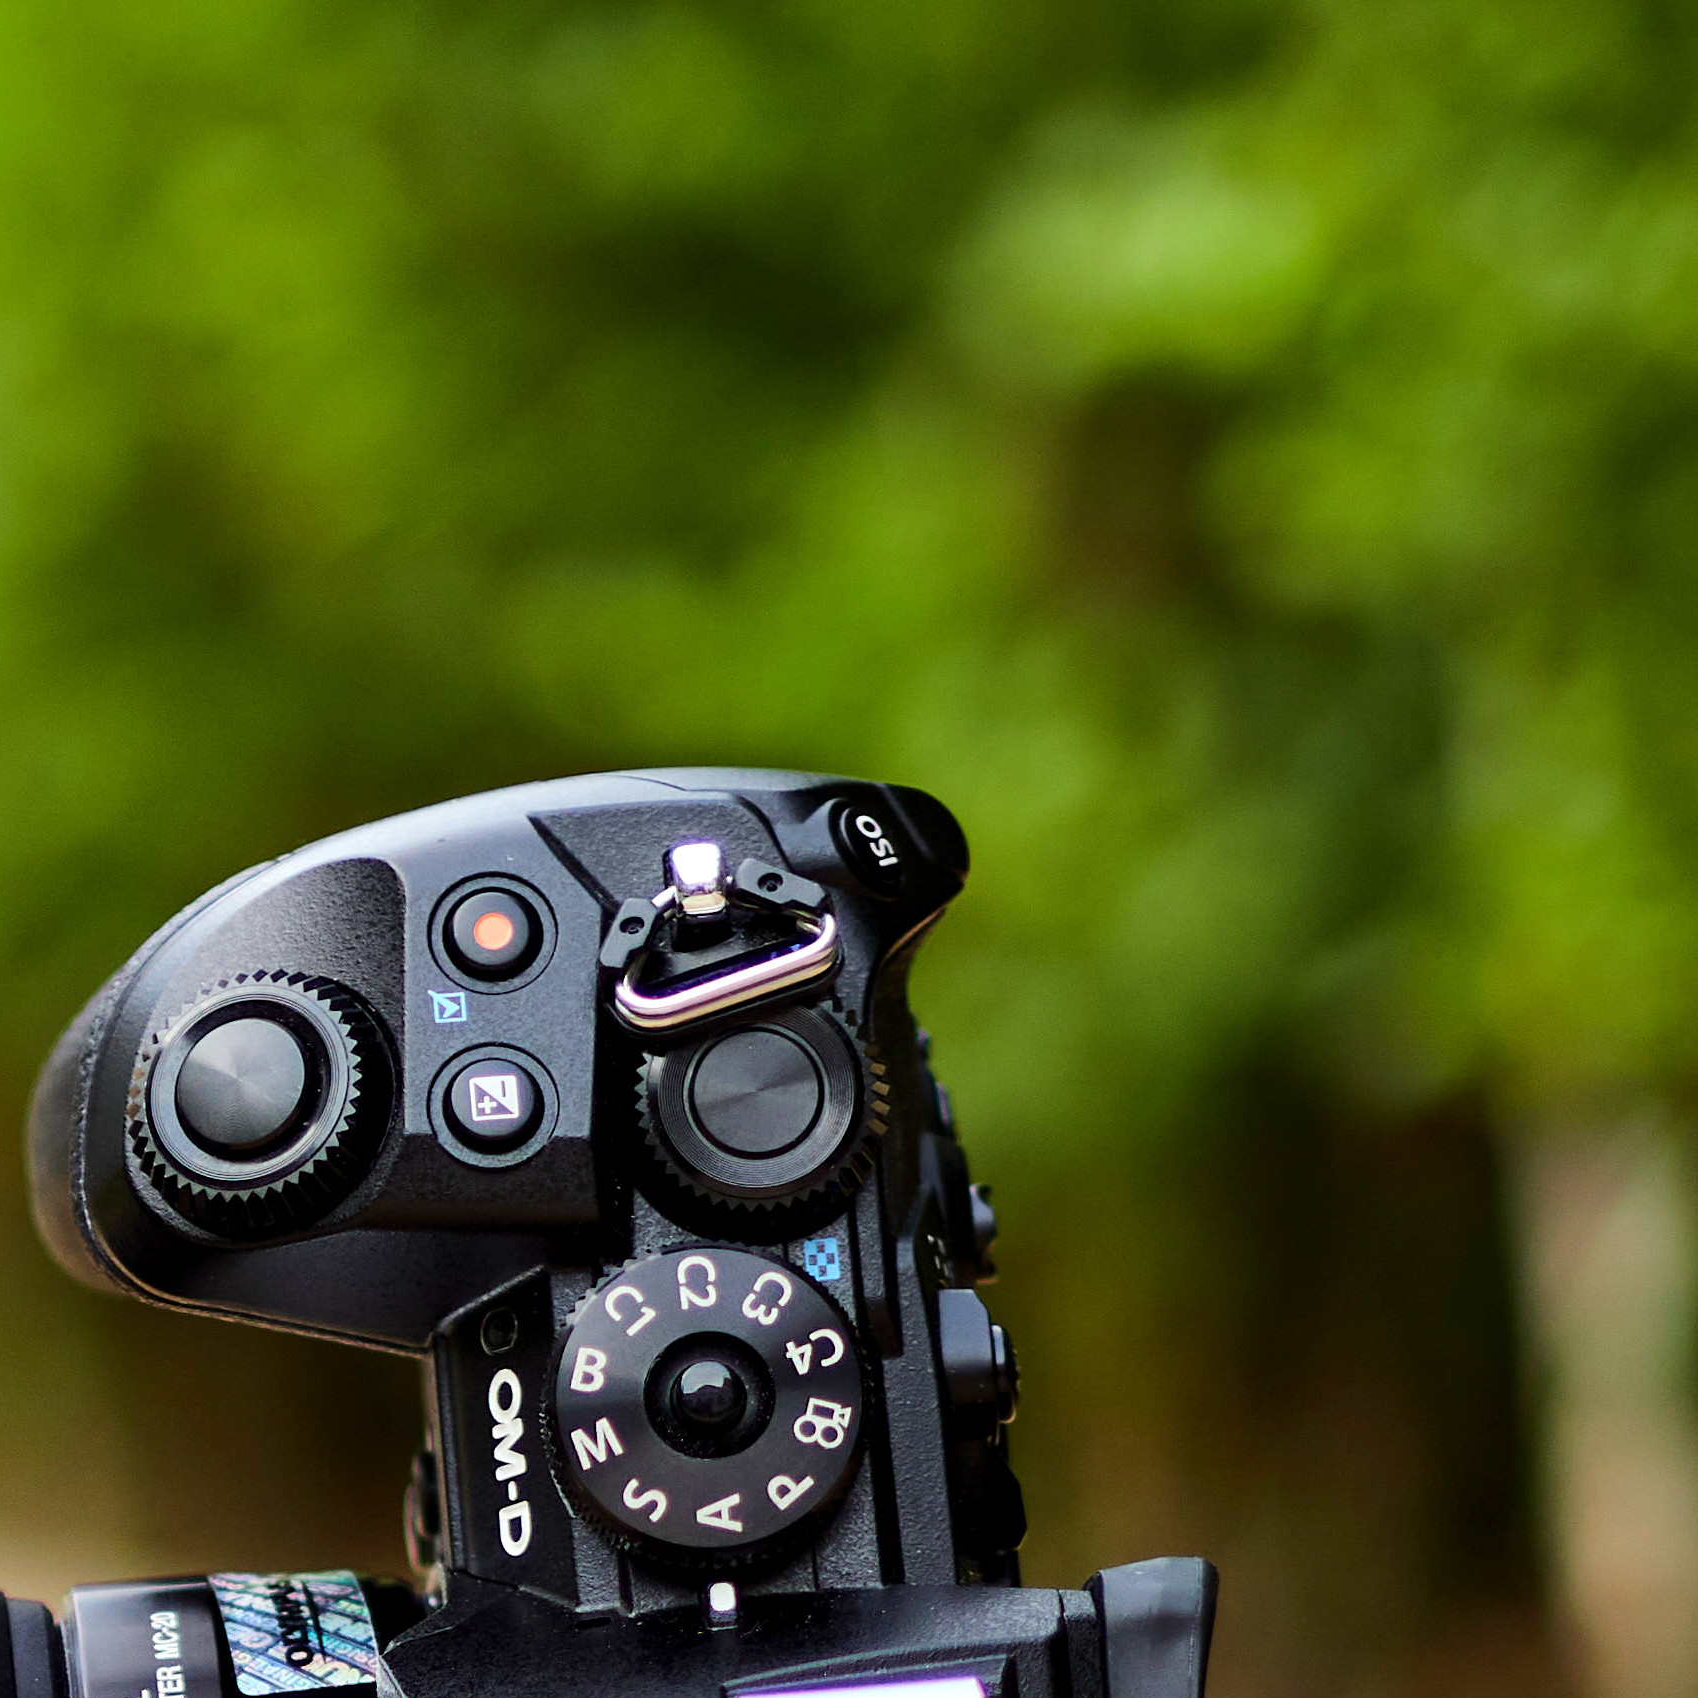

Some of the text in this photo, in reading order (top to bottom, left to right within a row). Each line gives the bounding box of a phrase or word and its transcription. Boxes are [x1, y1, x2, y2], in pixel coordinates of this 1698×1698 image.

[855, 815, 898, 867] ISO
[677, 1256, 717, 1310] C2
[742, 1271, 792, 1326] C3
[605, 1285, 656, 1337] C1
[570, 1347, 608, 1392] B
[785, 1328, 845, 1376] C4
[488, 1368, 532, 1557] OM-D
[570, 1417, 624, 1471] M
[623, 1478, 668, 1523] S
[696, 1492, 743, 1533] A
[767, 1475, 815, 1511] P
[150, 1611, 182, 1660] MC-20
